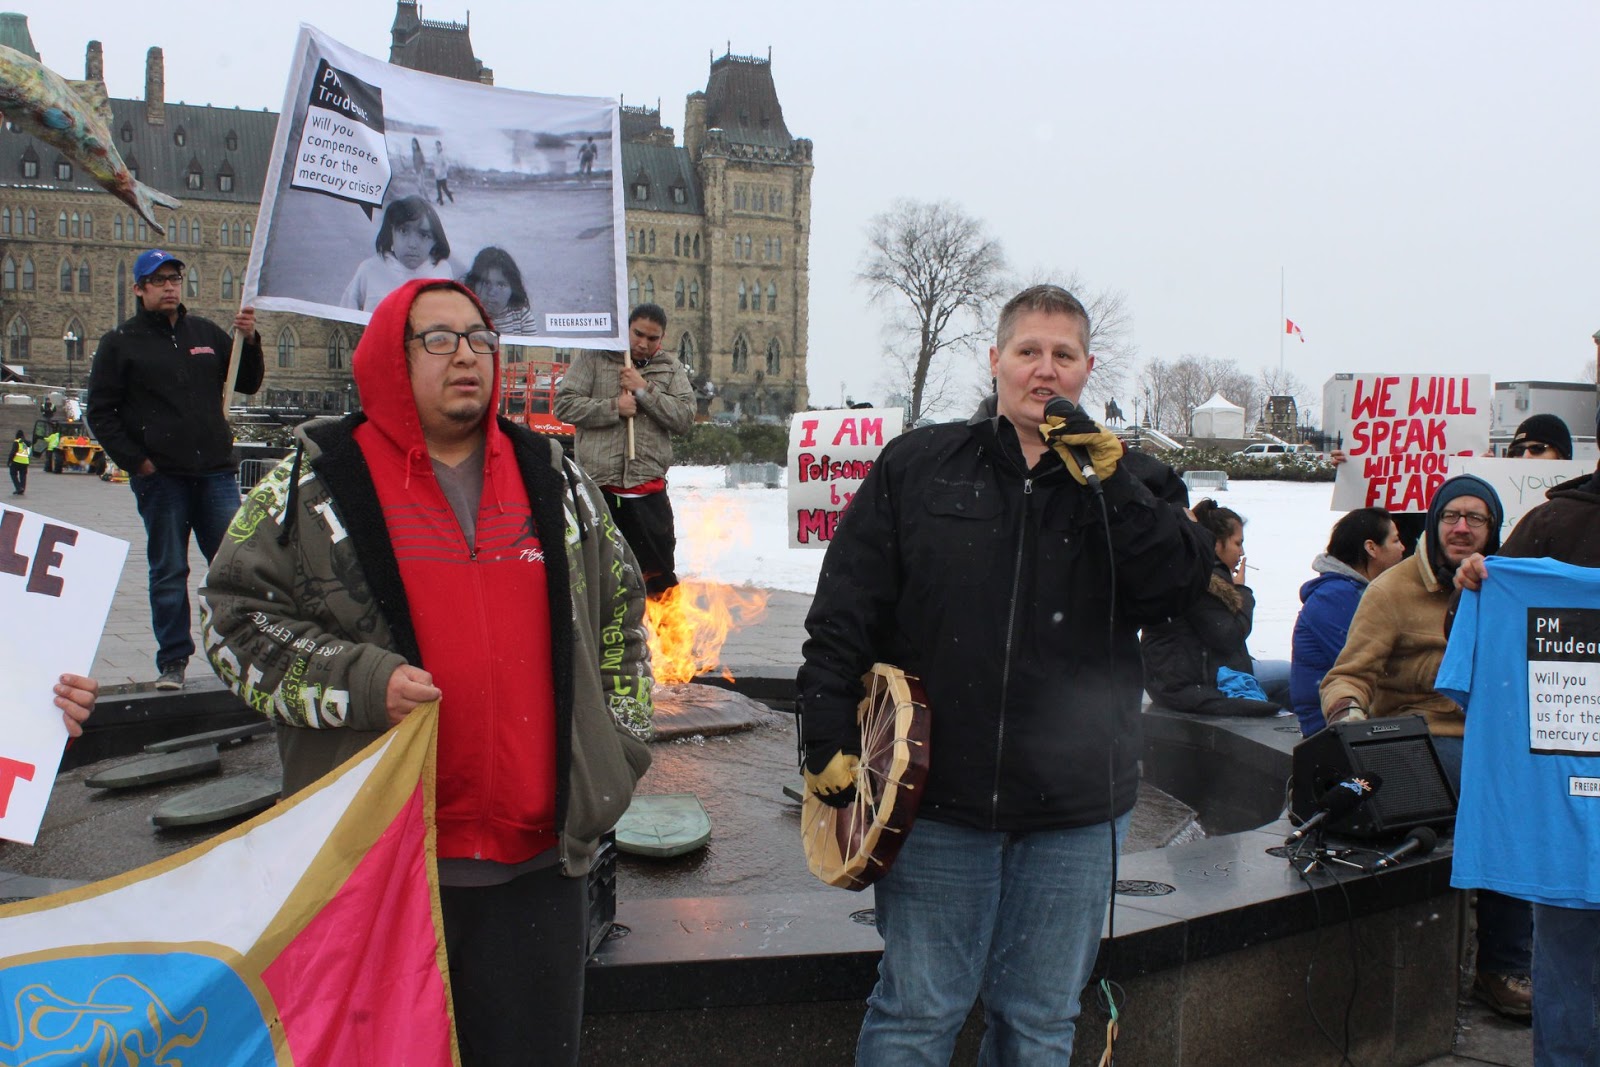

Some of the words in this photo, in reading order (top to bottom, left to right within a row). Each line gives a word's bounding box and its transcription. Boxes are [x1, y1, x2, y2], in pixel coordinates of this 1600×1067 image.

[312, 115, 331, 131] Will
[331, 123, 354, 137] you
[307, 135, 379, 165] compensate
[302, 152, 316, 164] us
[320, 156, 339, 170] for
[341, 159, 358, 174] the
[299, 168, 347, 191] mercury
[348, 179, 382, 197] crisis?
[550, 317, 608, 327] FREEGRASSY.NET
[1351, 376, 1400, 420] WE
[1408, 376, 1477, 417] WILL
[799, 420, 819, 447] I
[832, 417, 883, 446] AM
[1349, 418, 1447, 456] SPEAK
[798, 453, 875, 483] Poisone
[1364, 450, 1473, 479] WITHOU
[1536, 617, 1560, 633] PM
[1535, 636, 1600, 654] Trudea
[1535, 671, 1559, 686] Will
[1562, 676, 1586, 690] you
[1537, 712, 1551, 722] us
[1556, 709, 1575, 723] for
[1580, 711, 1600, 724] the
[1536, 729, 1590, 746] mercury
